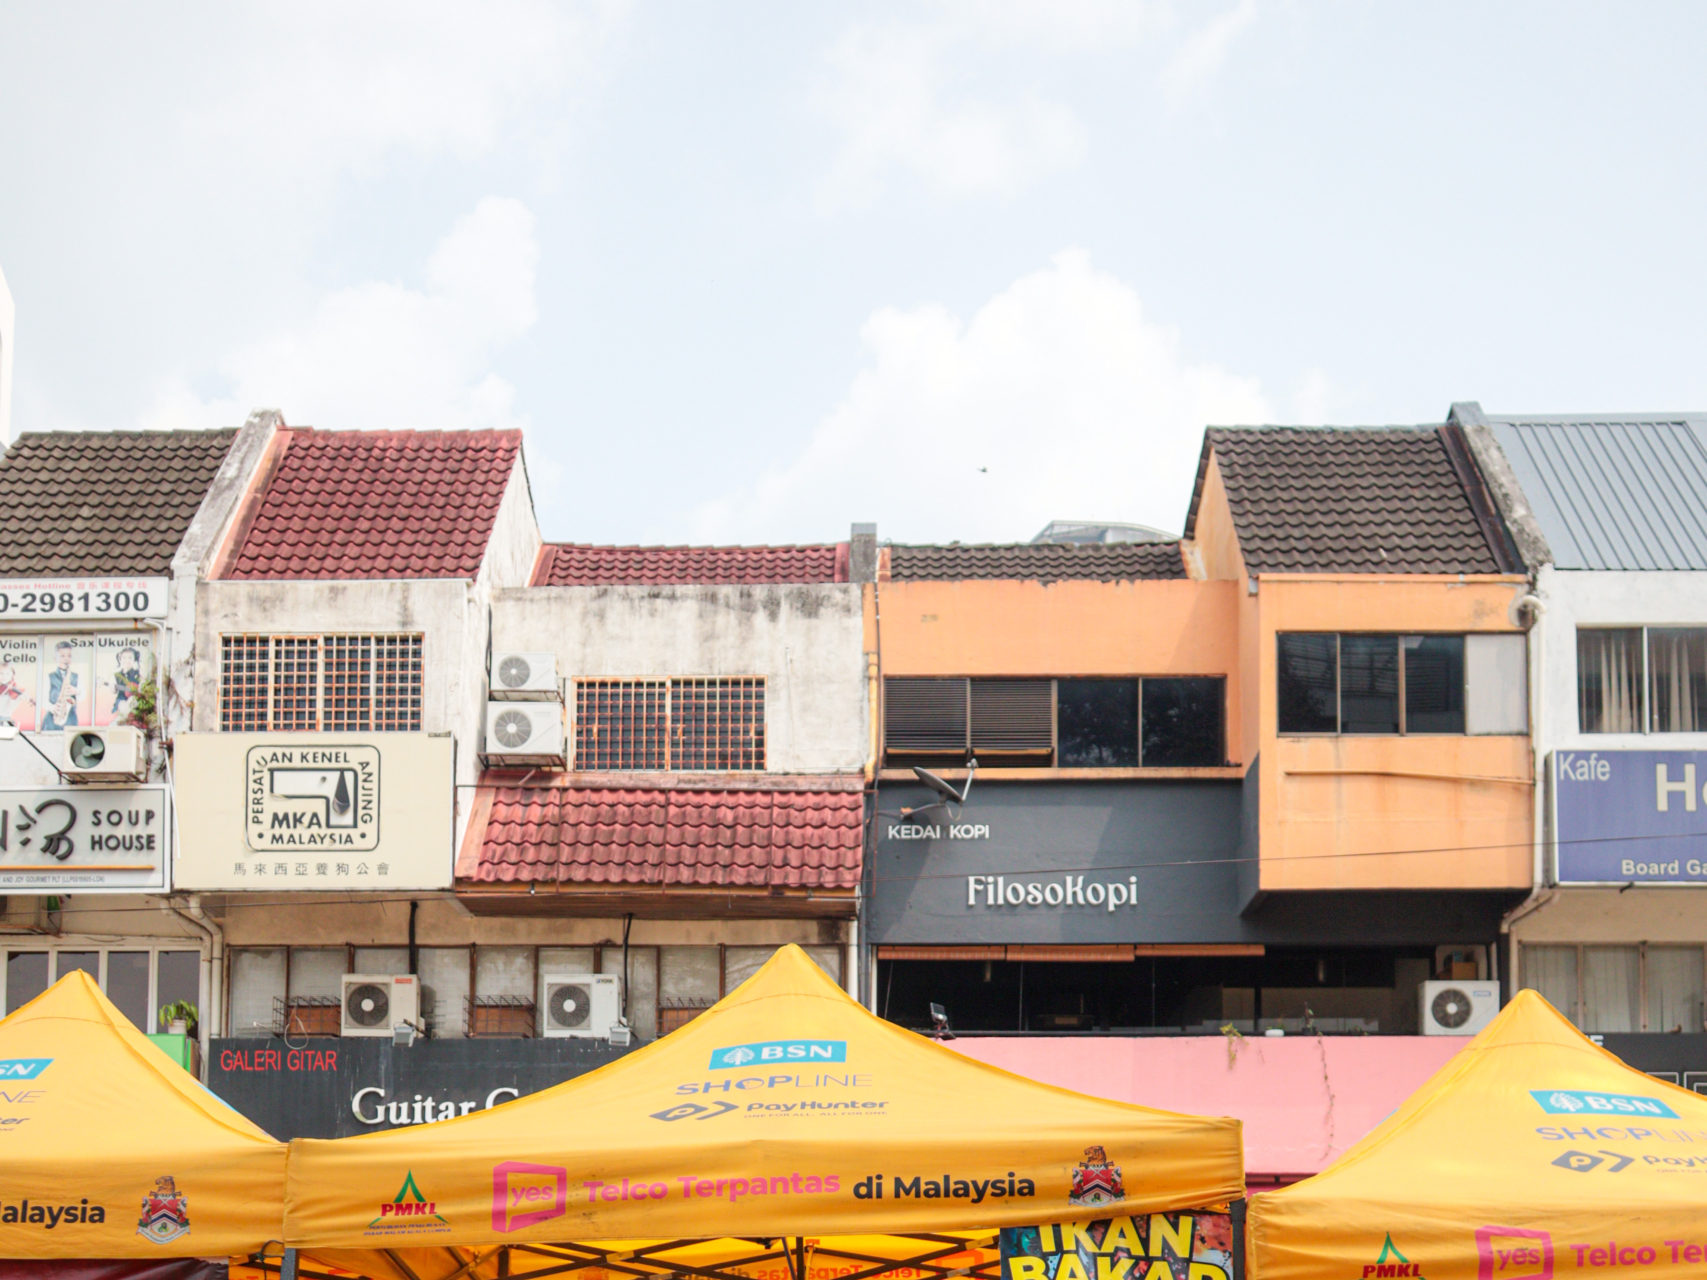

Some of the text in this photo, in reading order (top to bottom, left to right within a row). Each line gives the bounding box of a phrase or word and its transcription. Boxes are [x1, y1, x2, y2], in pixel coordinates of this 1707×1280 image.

[0, 591, 149, 613] 0-2981300
[0, 639, 37, 649] Violin
[70, 638, 149, 647] Sax Ukulele
[3, 653, 37, 663] Cello
[300, 752, 350, 763] KENEL
[1559, 753, 1611, 781] Kafe
[358, 761, 373, 824] ANJING
[1656, 763, 1707, 812] H
[91, 809, 155, 826] SOUP
[270, 812, 322, 829] MKA
[270, 833, 354, 845] MALAYSIA
[888, 824, 989, 840] KEDAI KOPI
[91, 834, 155, 851] HOUSE
[1621, 859, 1679, 875] Board
[220, 1050, 337, 1071] GALERI GITAR
[761, 1045, 833, 1060] BSN
[674, 1074, 873, 1095] SHOPLINE
[352, 1087, 476, 1125] Guitar
[1584, 1096, 1662, 1114] BSN
[511, 1184, 553, 1207] yes
[583, 1171, 1035, 1204] Telco Terpantas di Malaysia
[0, 1198, 105, 1229] alaysia
[381, 1202, 437, 1216] PMKL
[1039, 1213, 1193, 1258] IKAN
[1496, 1246, 1540, 1270] yes
[1569, 1241, 1656, 1267] Telco
[1362, 1264, 1422, 1278] PMKL
